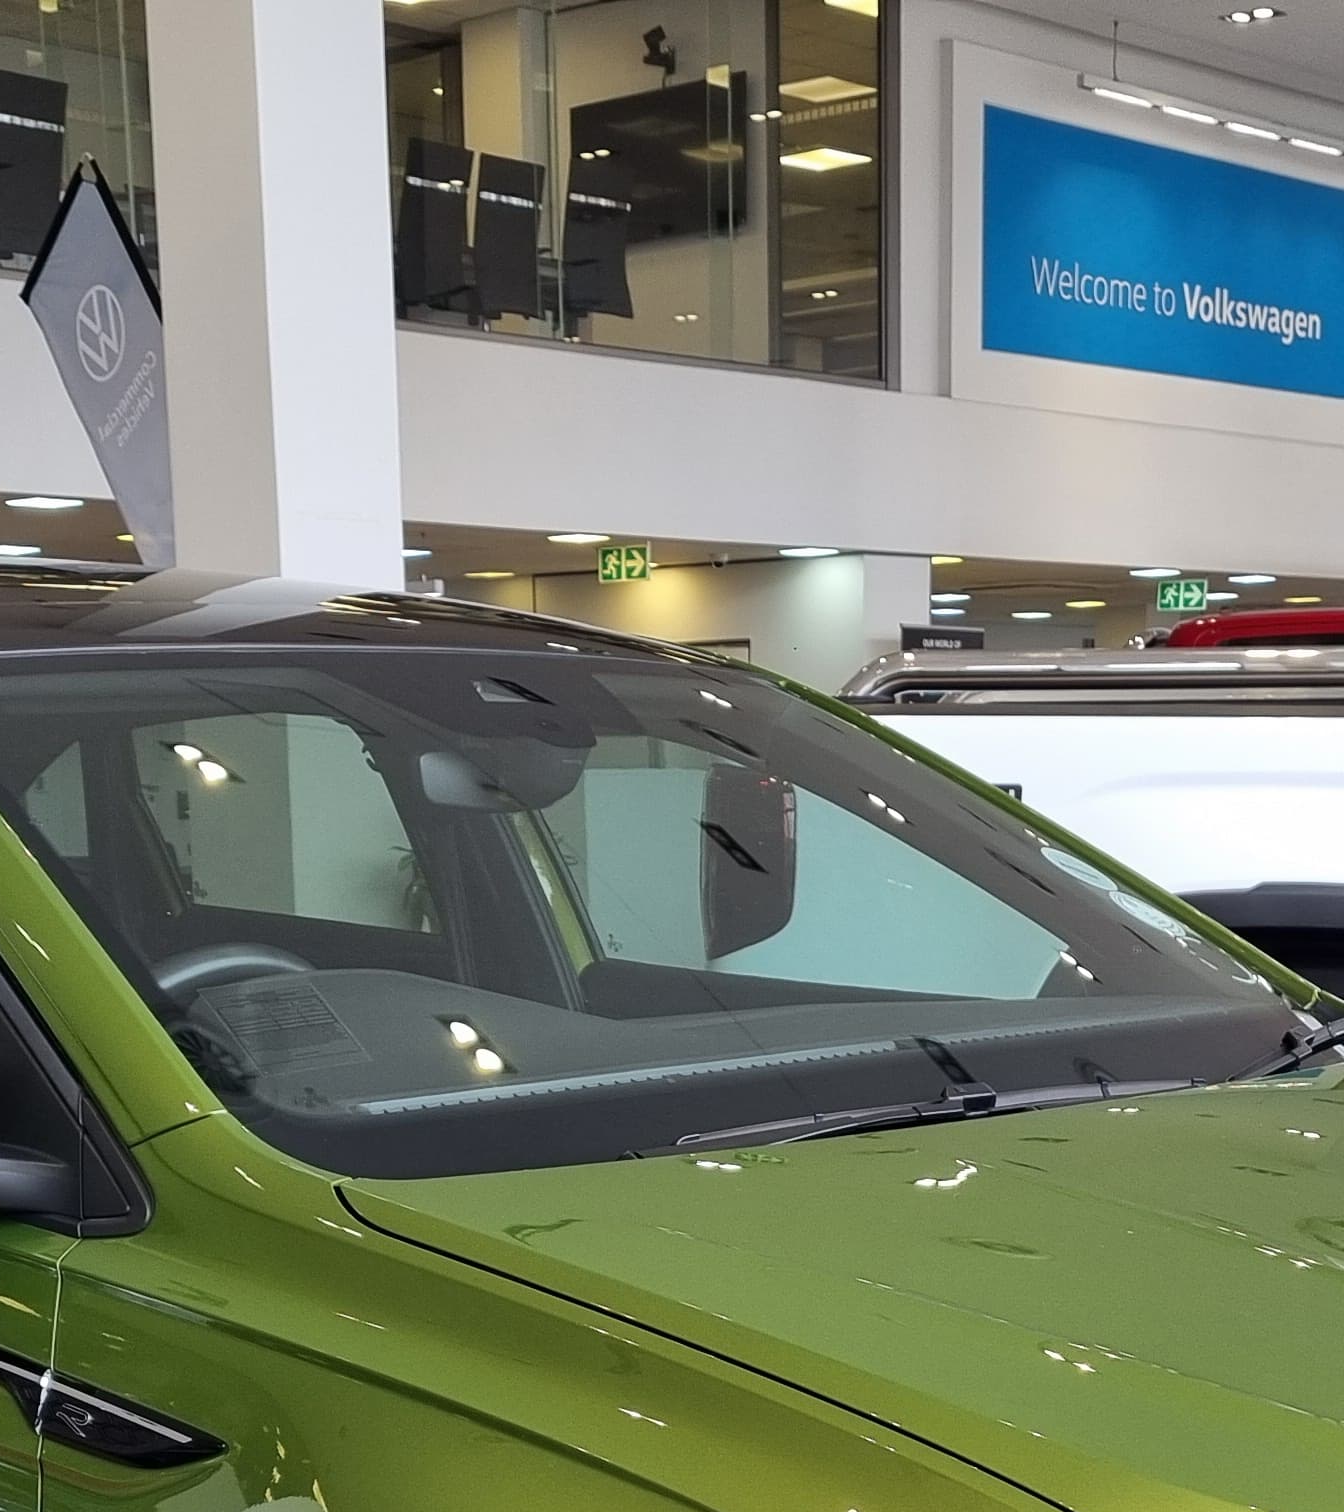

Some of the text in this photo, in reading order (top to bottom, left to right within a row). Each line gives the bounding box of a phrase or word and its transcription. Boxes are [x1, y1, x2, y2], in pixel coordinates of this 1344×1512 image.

[1030, 255, 1322, 345] Welcome to Volkswagen
